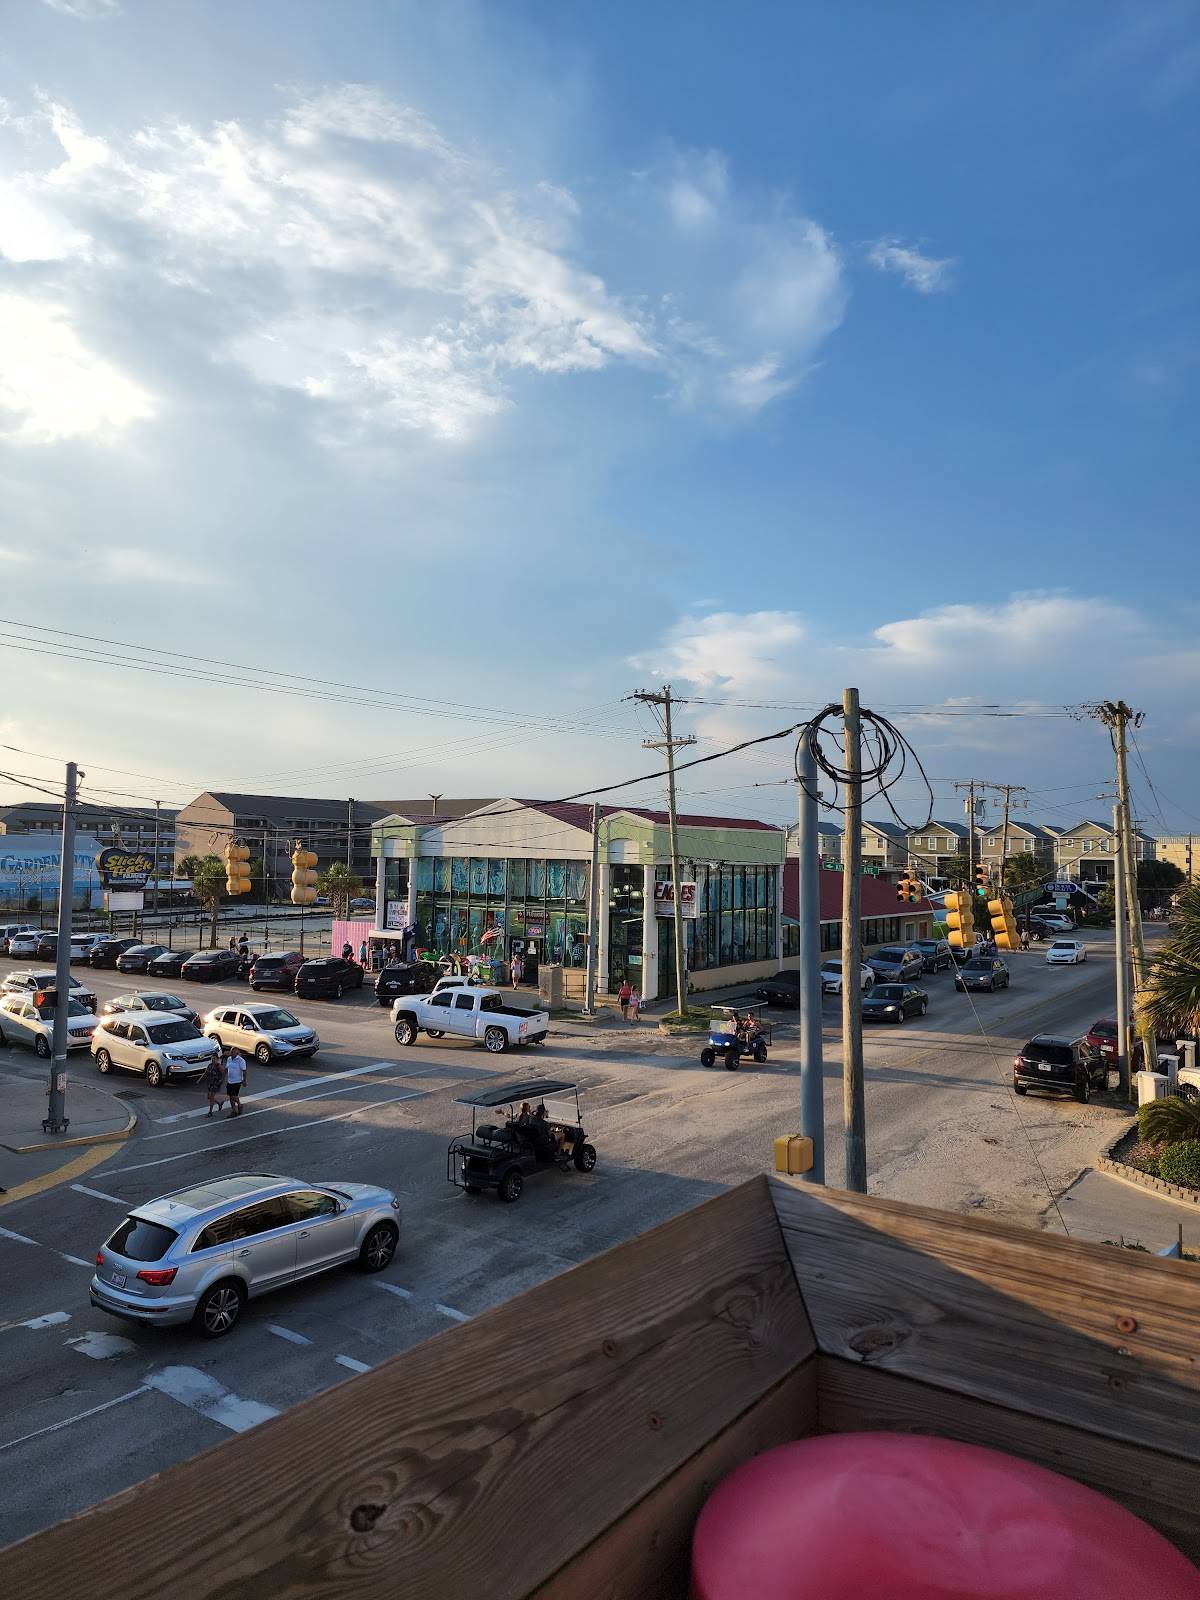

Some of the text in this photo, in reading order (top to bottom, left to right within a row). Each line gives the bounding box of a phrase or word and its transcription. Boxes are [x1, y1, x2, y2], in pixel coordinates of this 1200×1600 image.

[72, 855, 96, 869] ITY
[104, 855, 145, 868] Slick
[109, 860, 153, 877] Track
[863, 866, 874, 874] AVE
[654, 881, 696, 902] EAGES
